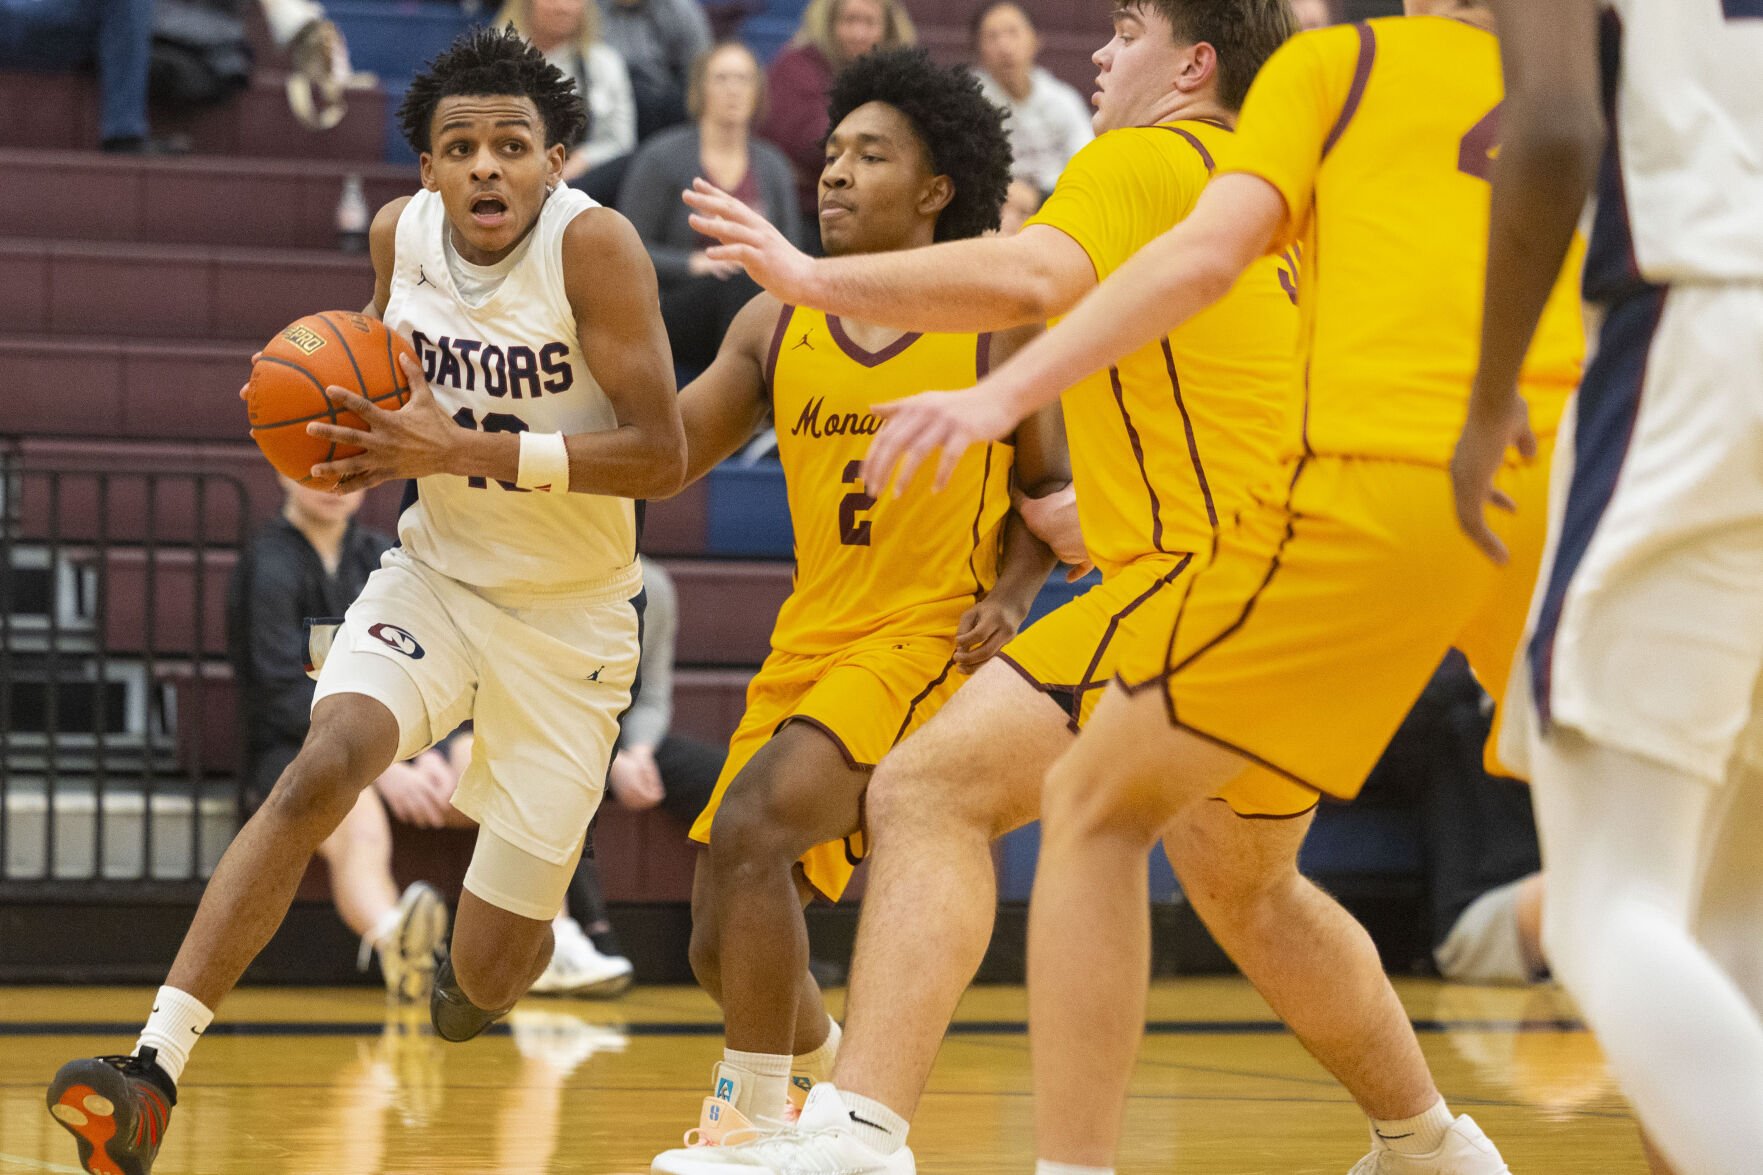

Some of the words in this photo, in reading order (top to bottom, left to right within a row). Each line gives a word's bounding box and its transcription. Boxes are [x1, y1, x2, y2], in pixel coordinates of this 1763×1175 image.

[411, 329, 574, 399] GATORS
[791, 396, 884, 439] Mona
[838, 459, 878, 546] 2
